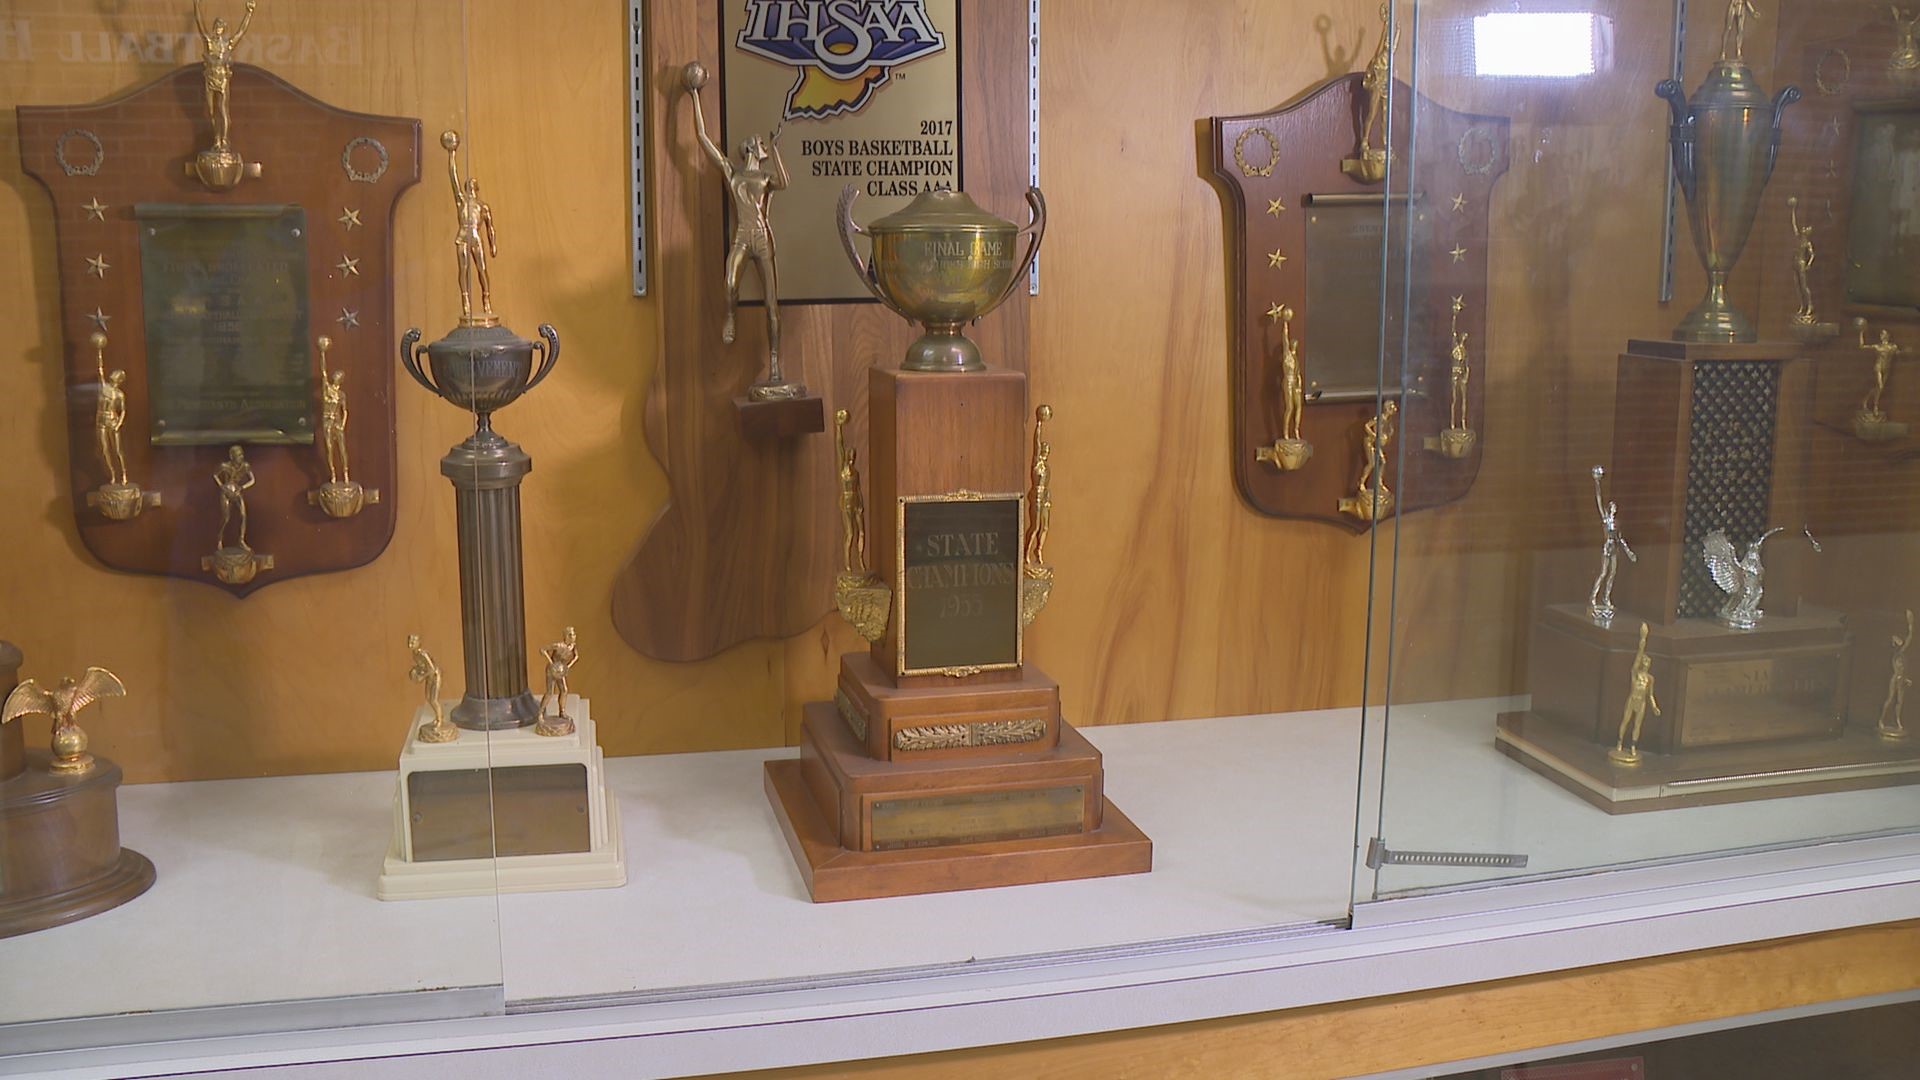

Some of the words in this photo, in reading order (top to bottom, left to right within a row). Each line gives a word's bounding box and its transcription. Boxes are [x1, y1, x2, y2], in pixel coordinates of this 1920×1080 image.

[745, 0, 942, 66] IHSAA
[920, 120, 952, 136] 2017
[801, 140, 843, 156] BOYS
[848, 139, 953, 156] BASKETBALL
[812, 160, 862, 177] STATE
[866, 160, 953, 176] CHAMPION
[867, 180, 918, 196] CLASS
[927, 532, 999, 557] STATE
